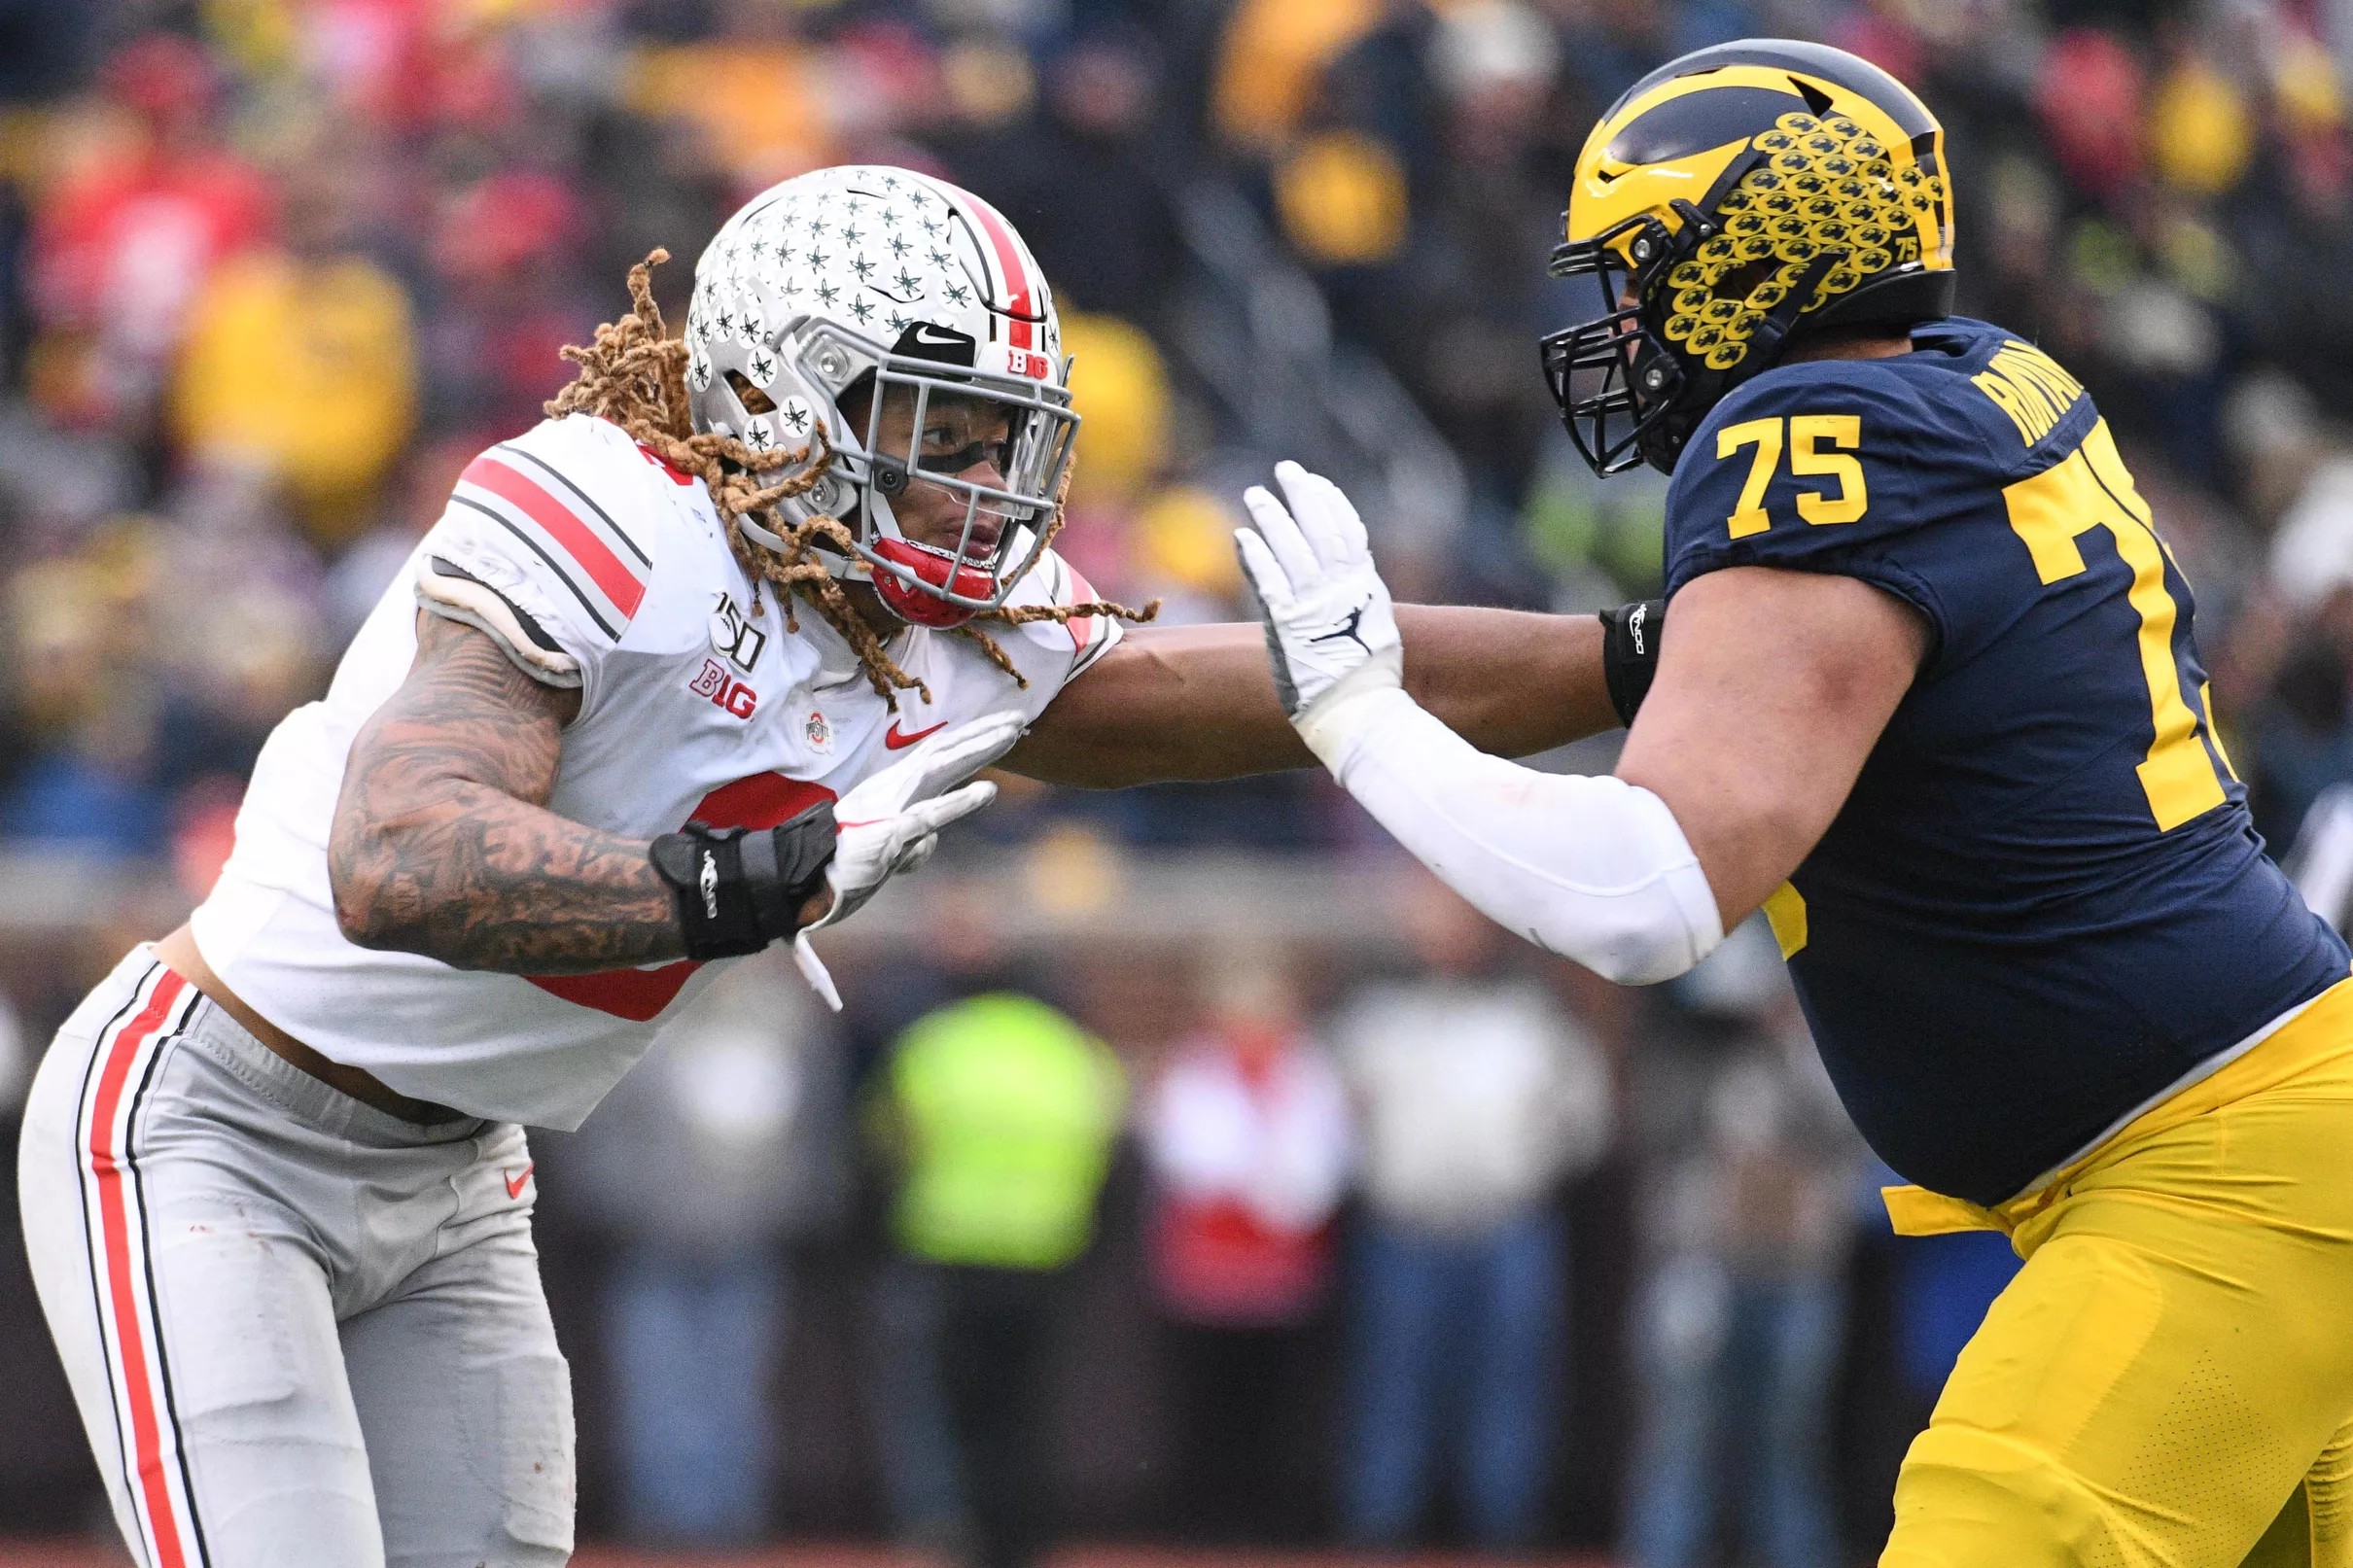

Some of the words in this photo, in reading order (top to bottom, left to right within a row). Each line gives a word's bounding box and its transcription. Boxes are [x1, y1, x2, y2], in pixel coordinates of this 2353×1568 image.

[1895, 236, 1917, 262] 75
[1716, 414, 1868, 540] 75
[2001, 416, 2239, 833] 7
